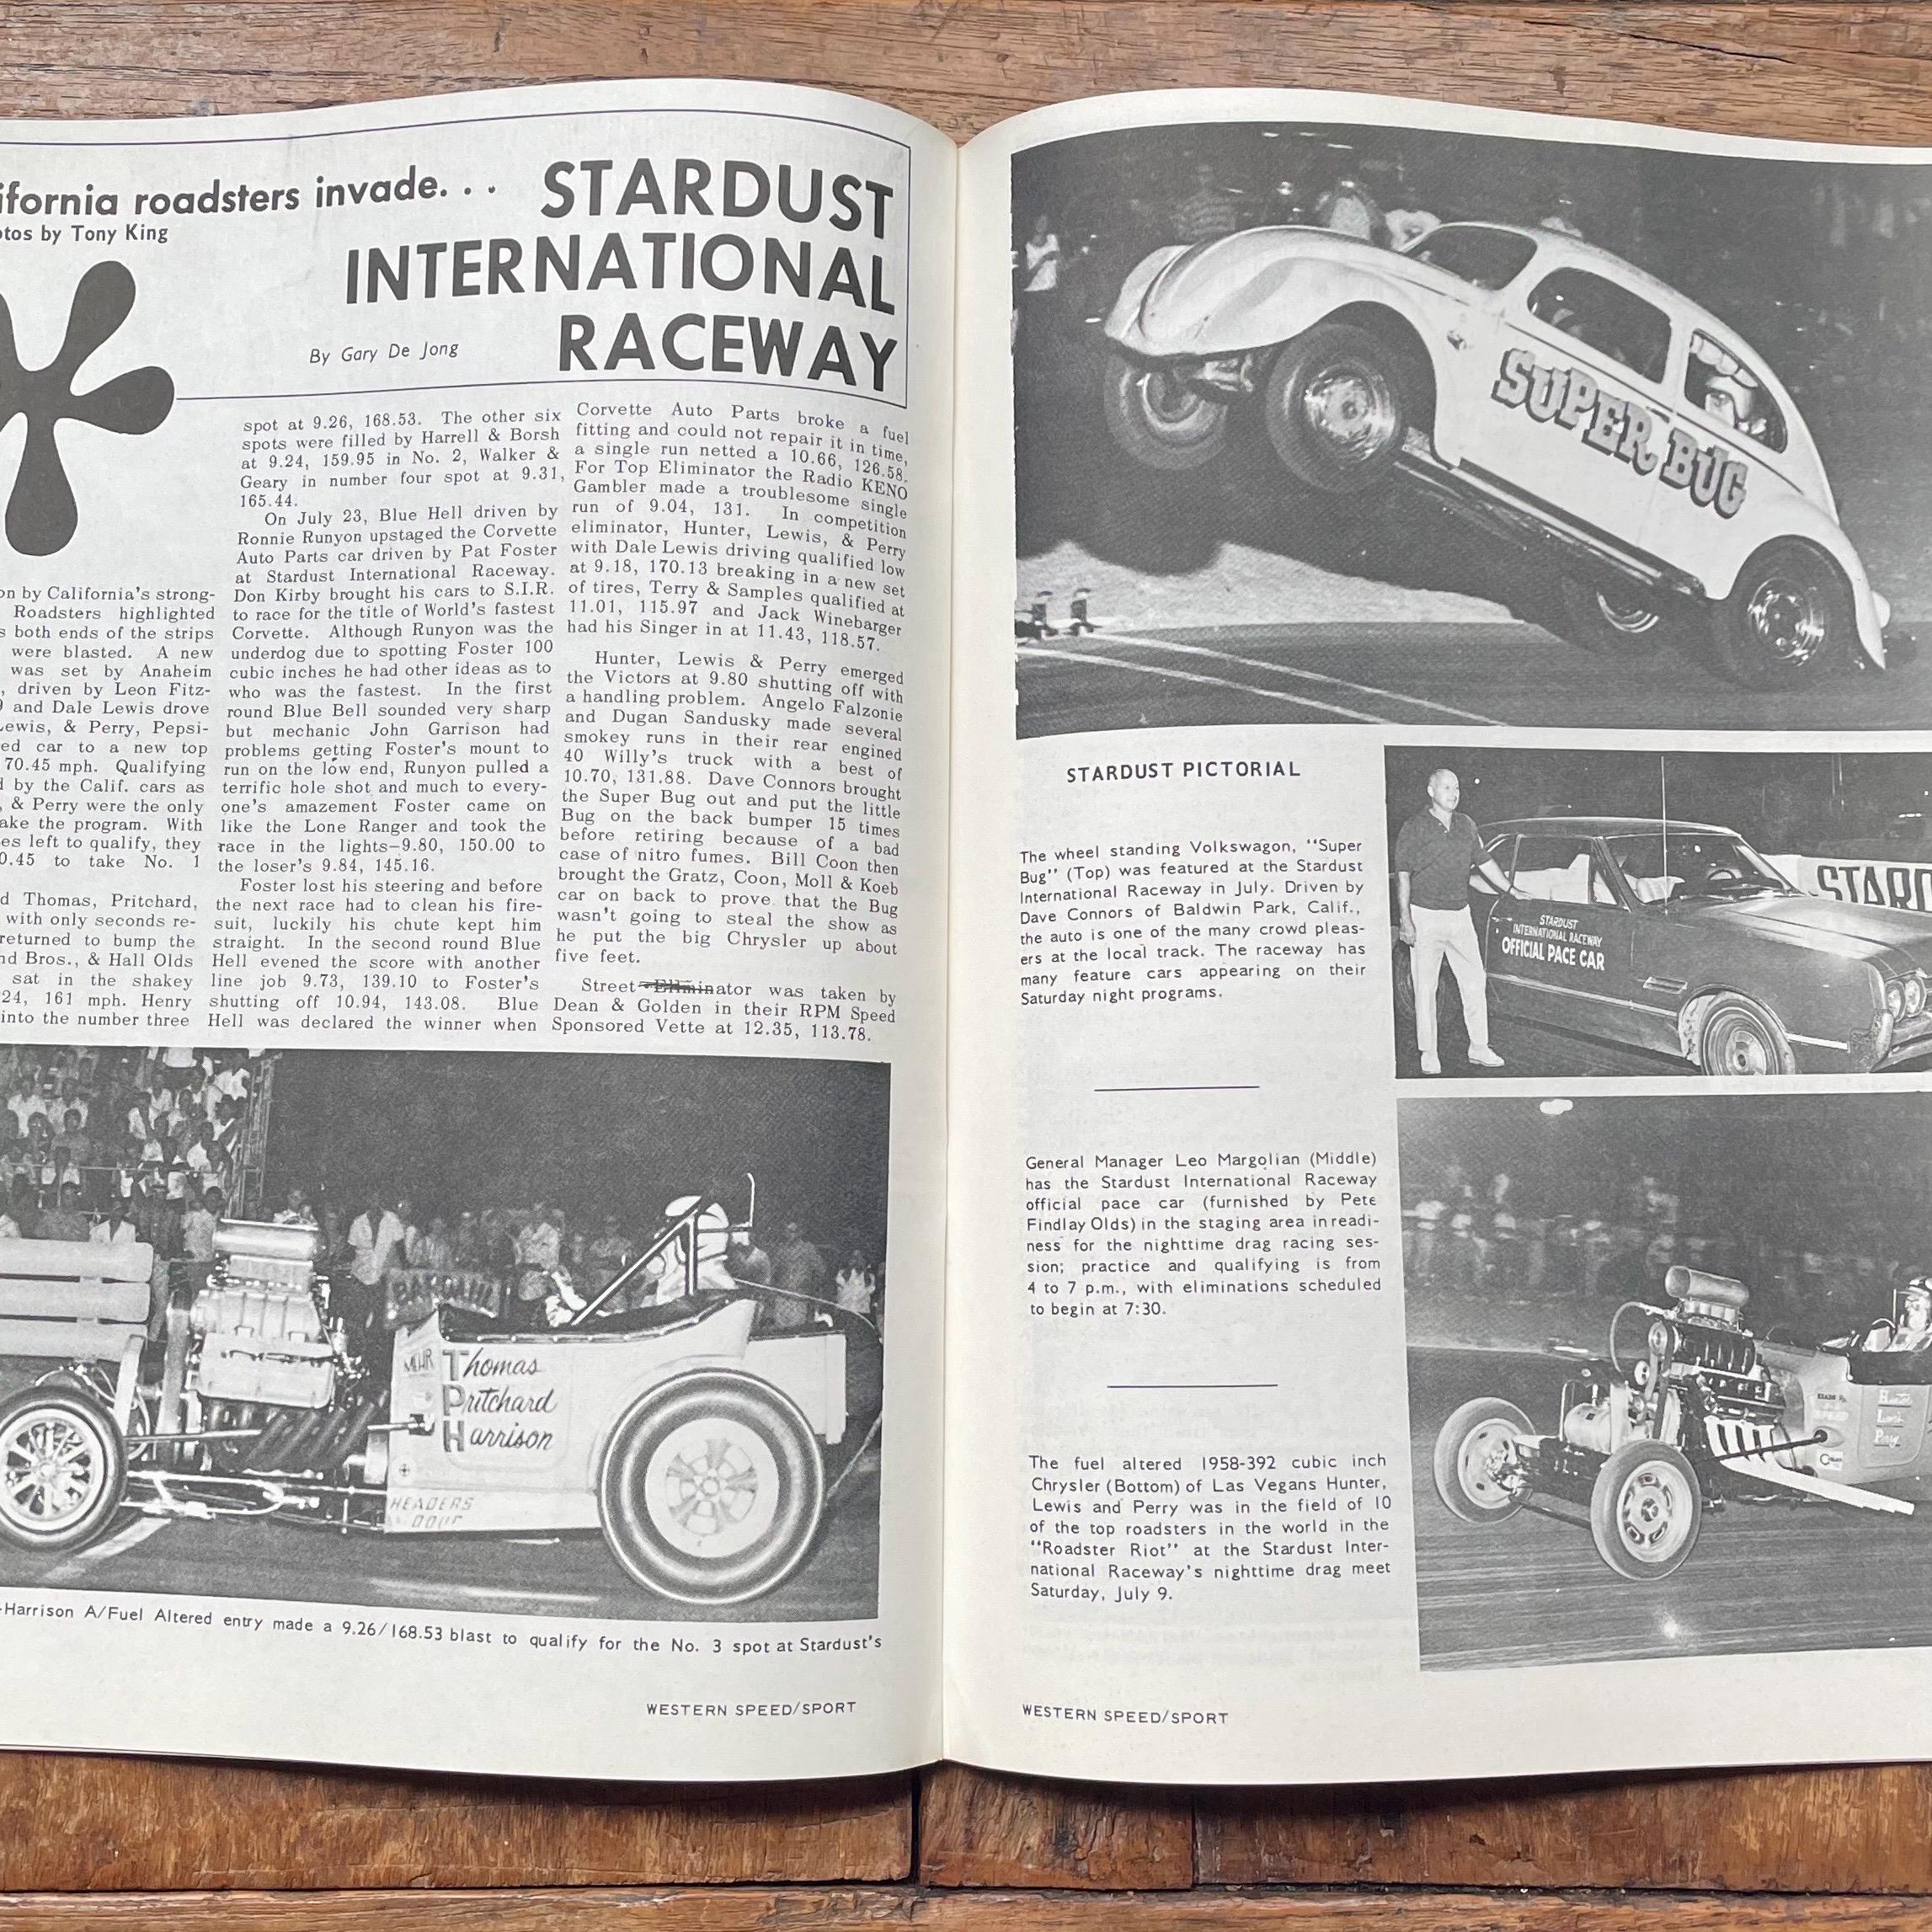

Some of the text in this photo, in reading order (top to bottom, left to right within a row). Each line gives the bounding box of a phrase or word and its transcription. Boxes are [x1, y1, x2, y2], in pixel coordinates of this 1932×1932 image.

[134, 178, 300, 216] roadsters
[540, 157, 894, 240] STARDUST
[0, 222, 168, 246] tos by Tony King
[345, 232, 896, 317] INTERNATIONAL
[309, 341, 459, 367] By Gary De Jong
[558, 312, 899, 393] RACEWAY
[243, 408, 562, 435] spot at 9.26, 168.53. The other six
[576, 401, 910, 446] Corvette Auto Parts broke a fuel
[1491, 347, 1749, 520] SUPER BUG
[22, 585, 42, 603] by
[46, 585, 151, 600] California's
[155, 588, 216, 605] strong-
[11, 644, 214, 659] were blasted. A new
[563, 748, 903, 782] 40 Willy's truck with a best of
[1066, 761, 1301, 783] STARDUST PICTORIAL
[1018, 850, 1047, 865] The
[1054, 845, 1099, 861] wheel
[1110, 841, 1181, 857] standing
[1189, 840, 1296, 856] Volkswagon,
[239, 878, 543, 896] Foster lost his steering and before
[1020, 879, 1364, 905] International Raceway in July. Driven by
[1020, 899, 1360, 925] Dave Connors of Baldwin Park, Calif.,
[1539, 914, 1579, 931] STARDUST
[1513, 923, 1604, 948] INTERNATIONAL RACEWAY
[1502, 936, 1605, 971] OFFICIAL PACE CAR
[12, 972, 194, 991] sat in the shakey
[552, 1016, 872, 1043] Sponsored Vette at 12.35, 113.78.
[1025, 1150, 1377, 1171] General Manager Leo Margolian (Middle)
[1025, 1172, 1377, 1191] has the Stardust International Raceway
[1027, 1277, 1381, 1297] 4 to 7 p.m., with eliminations scheduled
[1030, 1301, 1166, 1319] to begin at 7:30.
[442, 1348, 543, 1382] Thomas
[442, 1385, 558, 1417] Pritchard
[443, 1420, 553, 1453] Harrison
[1027, 1452, 1386, 1471] The fuel altered 1958-392 cubic inch
[1031, 1476, 1386, 1497] Chrysler (Bottom) of Las Vegans Hunter,
[1030, 1582, 1173, 1604] Saturday, July 9.
[83, 1604, 143, 1621] A/Fuel
[153, 1608, 212, 1625] Altered
[222, 1616, 264, 1631] entry
[273, 1617, 313, 1632] made
[323, 1622, 333, 1633] a
[342, 1620, 443, 1641] 9.26/168.53
[450, 1627, 492, 1644] blast
[502, 1633, 517, 1645] to
[529, 1633, 588, 1652] qualify
[599, 1636, 622, 1651] for
[632, 1636, 660, 1652] the
[671, 1637, 699, 1653] No.
[712, 1638, 722, 1654] 3
[732, 1641, 771, 1657] spot
[776, 1641, 793, 1653] at
[799, 1634, 883, 1652] Stardust's
[646, 1700, 857, 1716] WESTERN SPEED/SPORT
[1022, 1703, 1229, 1725] WESTERN SPEED/SPORT
